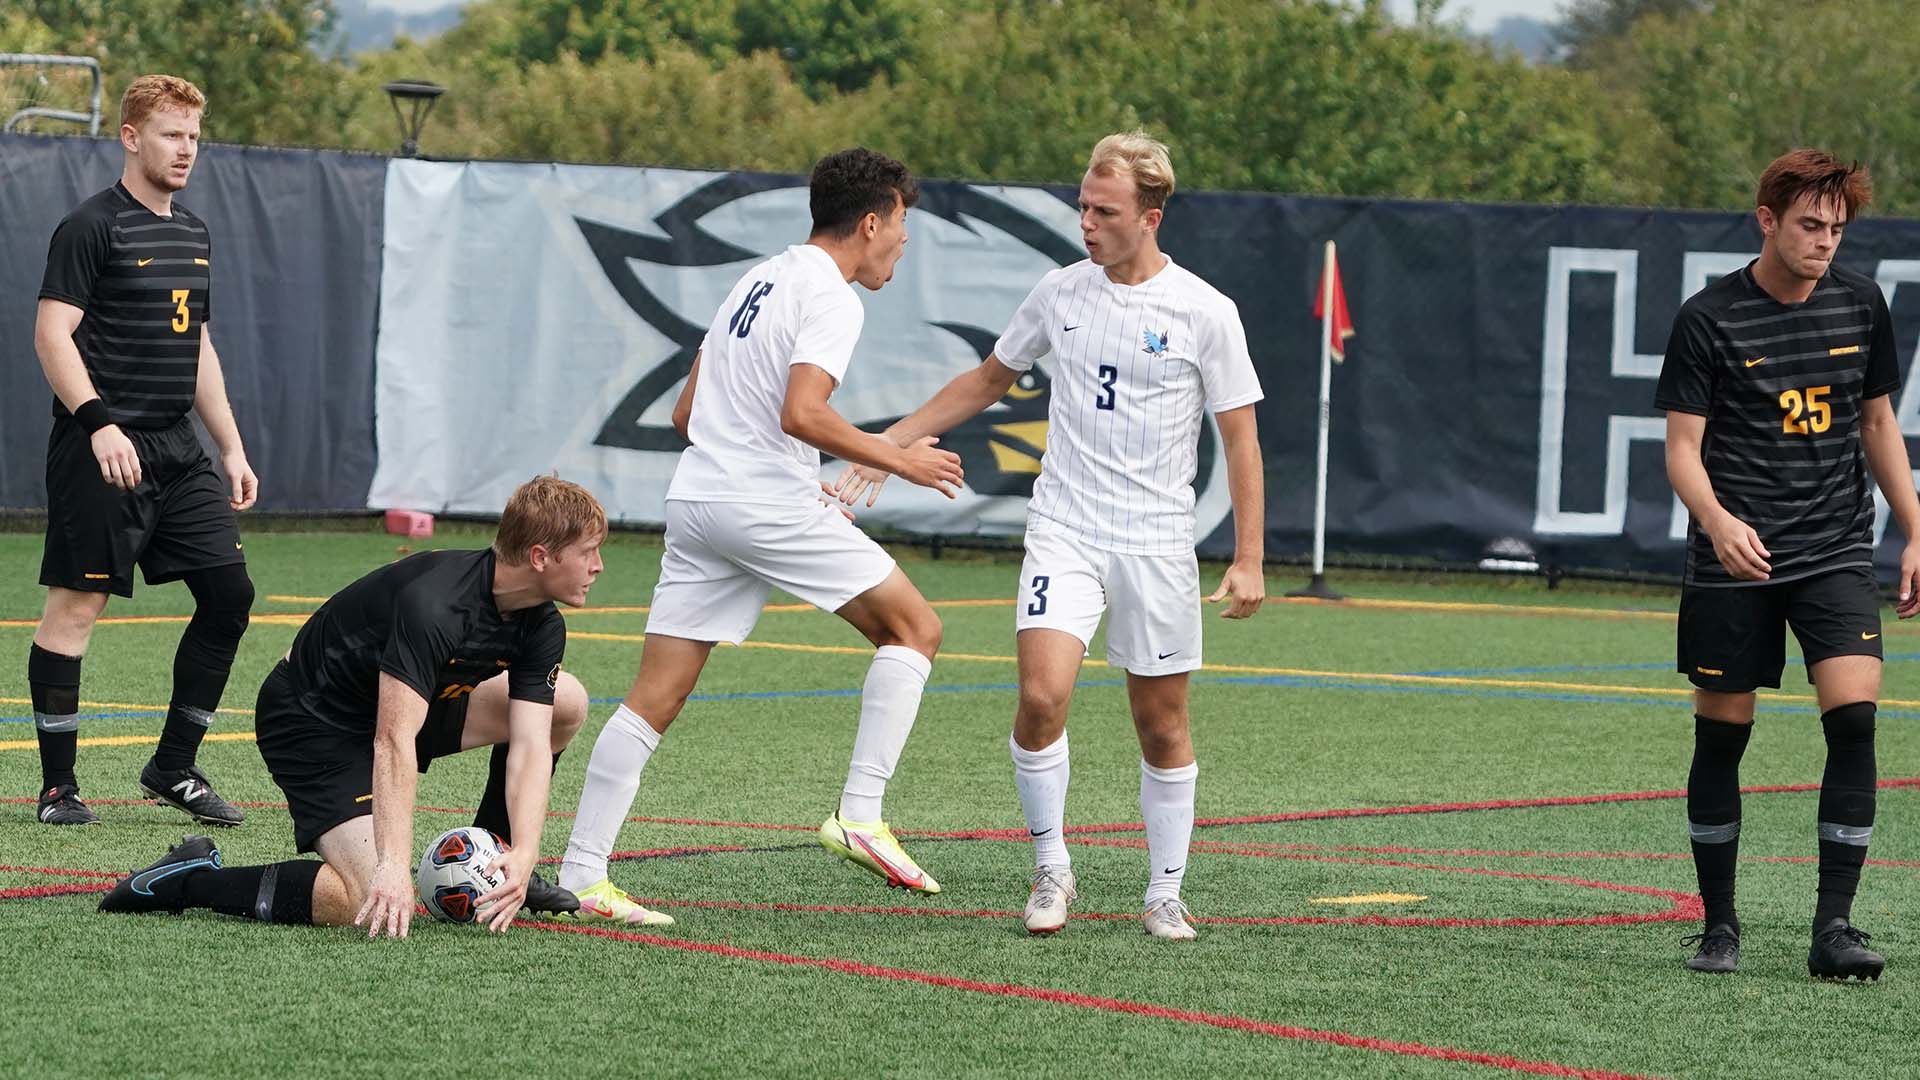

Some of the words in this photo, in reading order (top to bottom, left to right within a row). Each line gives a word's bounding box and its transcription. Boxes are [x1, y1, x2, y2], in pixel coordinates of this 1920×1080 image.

[172, 289, 190, 333] 3
[729, 280, 774, 338] 16
[1096, 365, 1117, 411] 3
[1779, 385, 1831, 435] 25
[1028, 575, 1050, 616] 3
